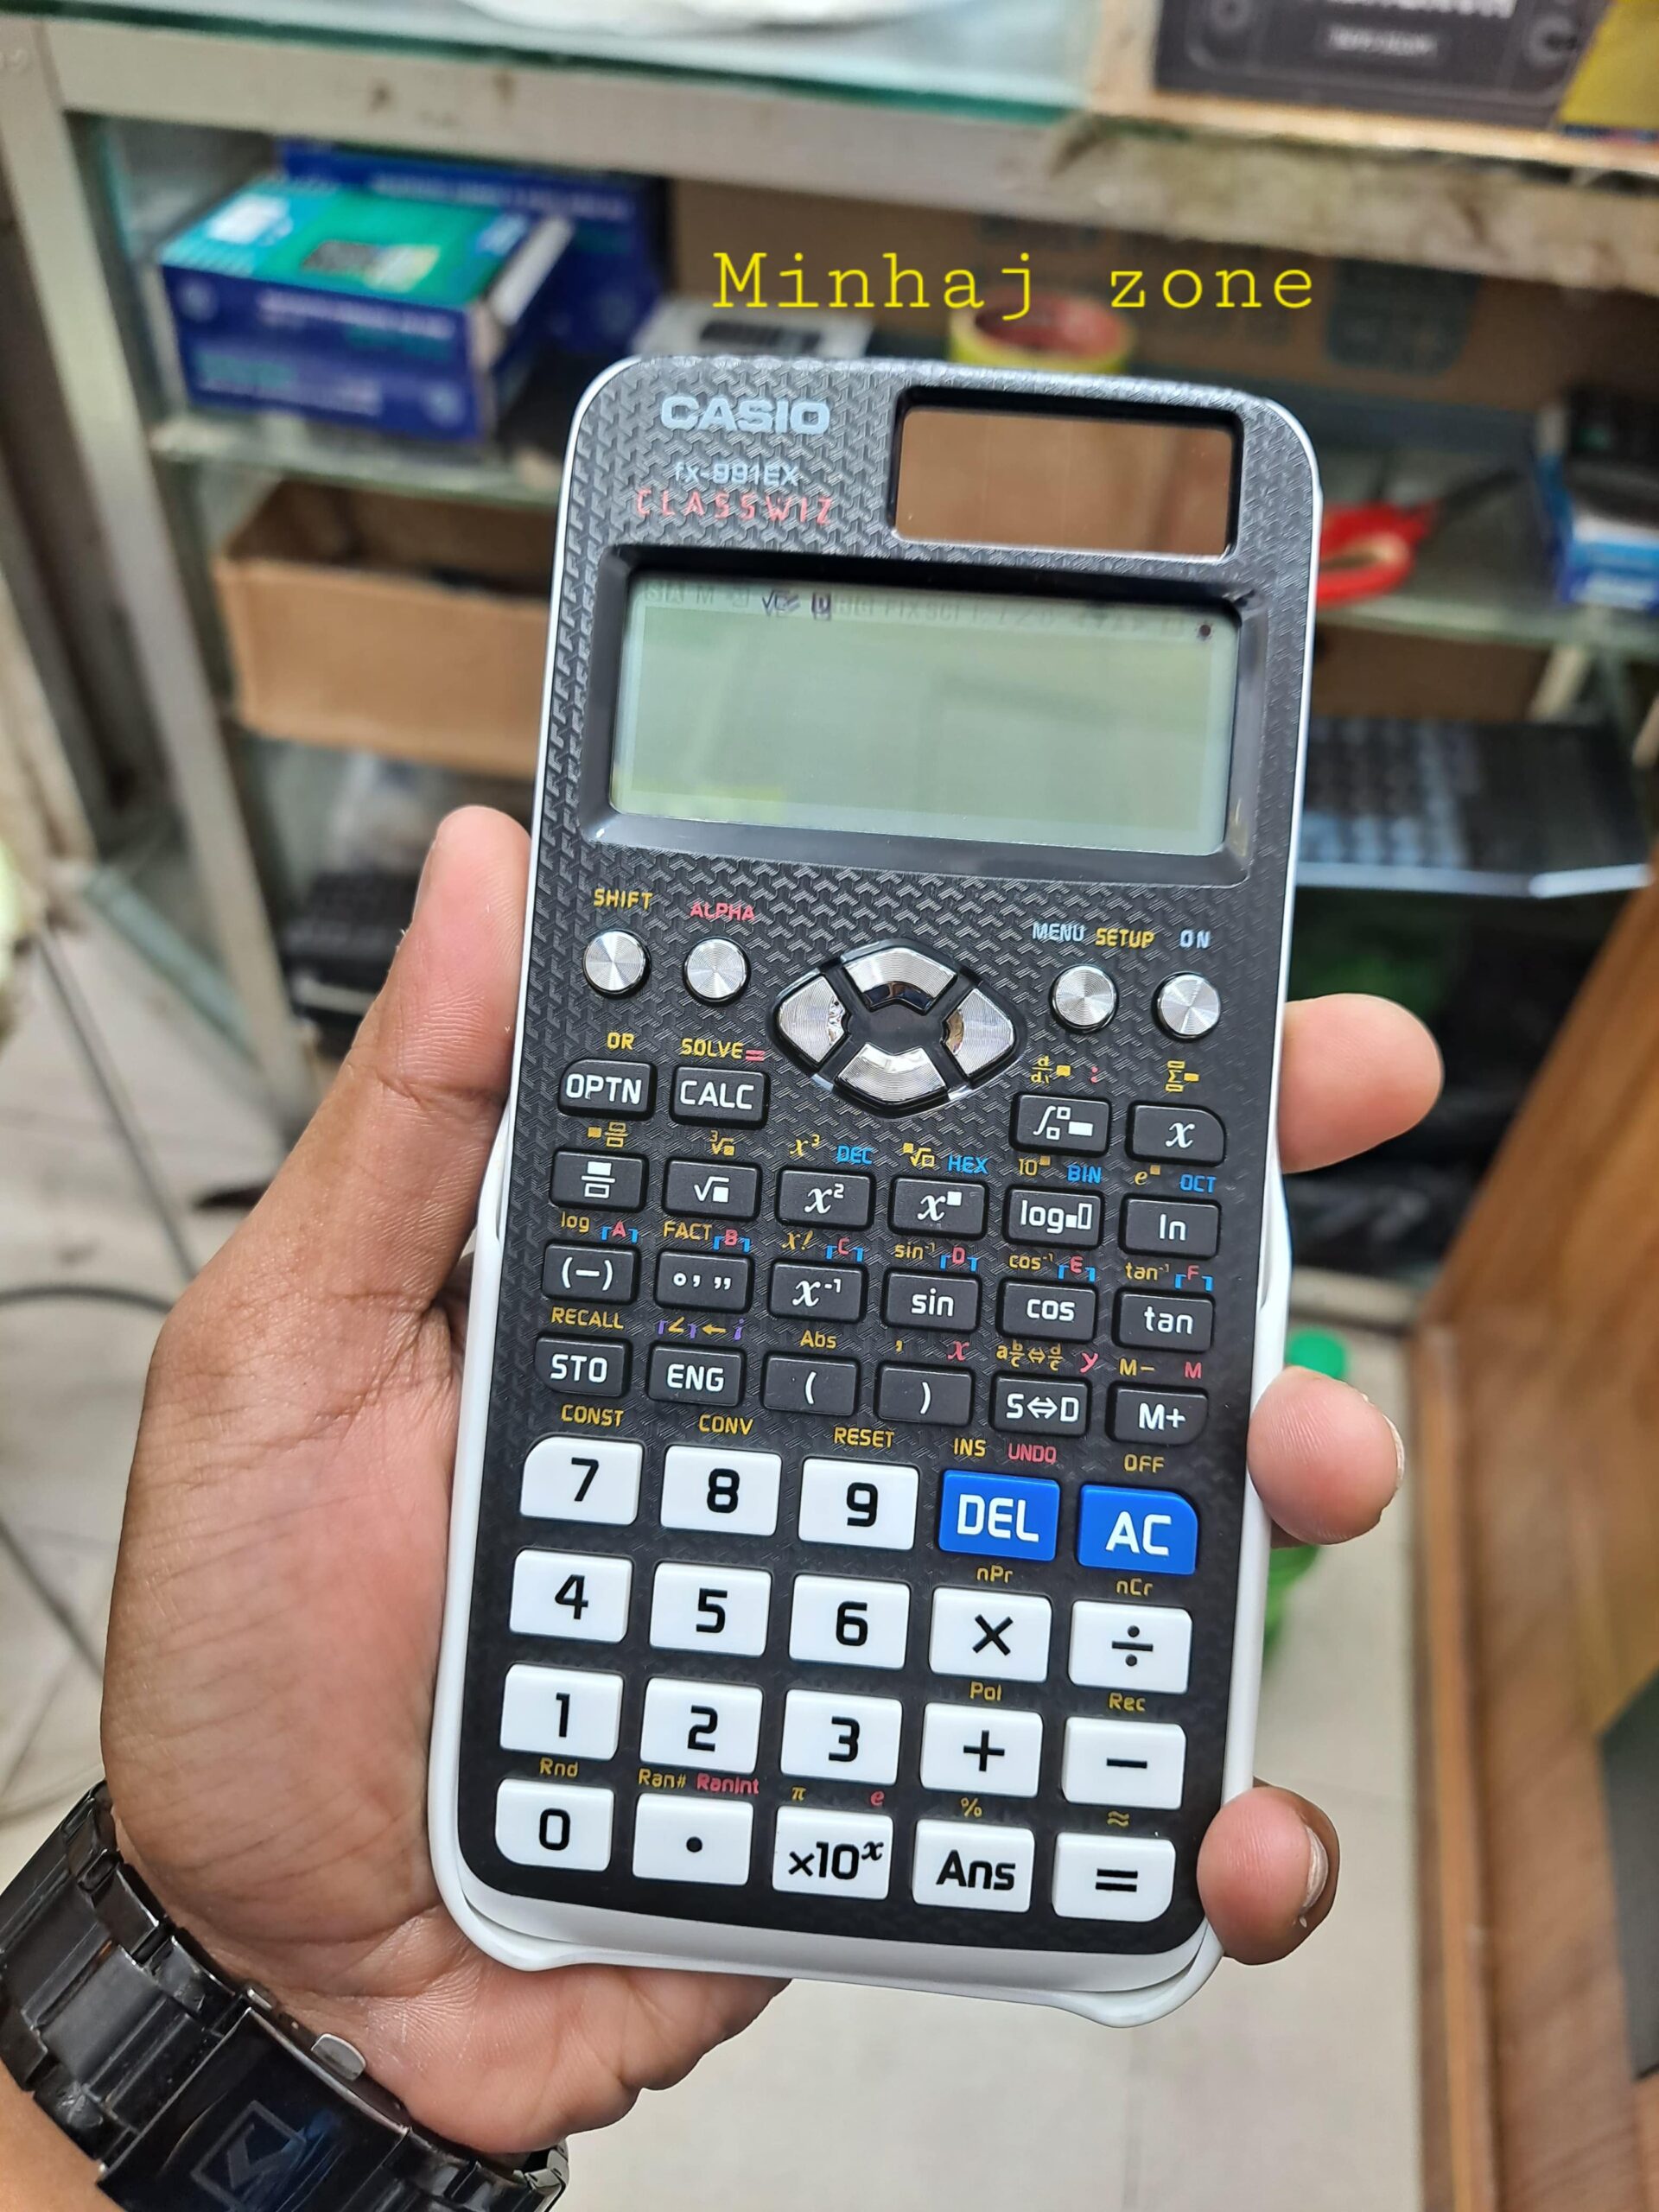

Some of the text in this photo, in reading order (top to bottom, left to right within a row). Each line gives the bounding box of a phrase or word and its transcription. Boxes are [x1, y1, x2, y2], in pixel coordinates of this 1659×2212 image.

[660, 396, 831, 435] CASIO
[675, 461, 799, 486] fx-991EX
[635, 486, 834, 526] CLASSWIZ
[593, 888, 654, 911] SHIFT
[690, 901, 756, 922] ALPHA
[1032, 921, 1156, 949] MENU SETUP
[1179, 929, 1211, 949] ON
[607, 1032, 636, 1051] OR
[680, 1038, 745, 1059] SOLVE
[565, 1073, 642, 1105] OPTN
[679, 1080, 755, 1110] CALC
[1165, 1122, 1196, 1148] x
[836, 1144, 874, 1165] DEC
[948, 1154, 989, 1174] HEX
[1066, 1164, 1103, 1185] BIN
[1179, 1173, 1217, 1194] OCT
[561, 1211, 590, 1233] log
[663, 1220, 713, 1241] FACT
[911, 1287, 955, 1317] sin
[1026, 1298, 1076, 1321] cos
[550, 1306, 625, 1330] RECALL
[1143, 1306, 1194, 1335] tan
[799, 1330, 836, 1350] Abs
[550, 1352, 608, 1382] STO
[666, 1363, 725, 1392] ENG
[1184, 1361, 1203, 1379] M
[562, 1403, 625, 1427] CONST
[698, 1414, 754, 1436] CONV
[1138, 1402, 1186, 1431] M+
[833, 1426, 895, 1448] RESET
[953, 1437, 987, 1458] INS
[1124, 1453, 1165, 1473] OFF
[570, 1456, 600, 1502] 7
[706, 1467, 741, 1514] 8
[846, 1481, 879, 1528] 9
[957, 1493, 1040, 1542] DEL
[1105, 1510, 1173, 1556] AC
[976, 1564, 1014, 1584] nPr
[554, 1573, 589, 1620] 4
[1116, 1577, 1154, 1596] nCr
[696, 1586, 728, 1635] 5
[835, 1600, 868, 1647] 6
[969, 1681, 1002, 1701] Pol
[1107, 1692, 1146, 1713] Rec
[556, 1692, 571, 1738] 1
[687, 1704, 719, 1752] 2
[828, 1715, 861, 1763] 3
[539, 1757, 579, 1777] Rnd
[638, 1768, 687, 1789] Ran#
[538, 1807, 571, 1851] 0
[935, 1849, 1017, 1891] Ans
